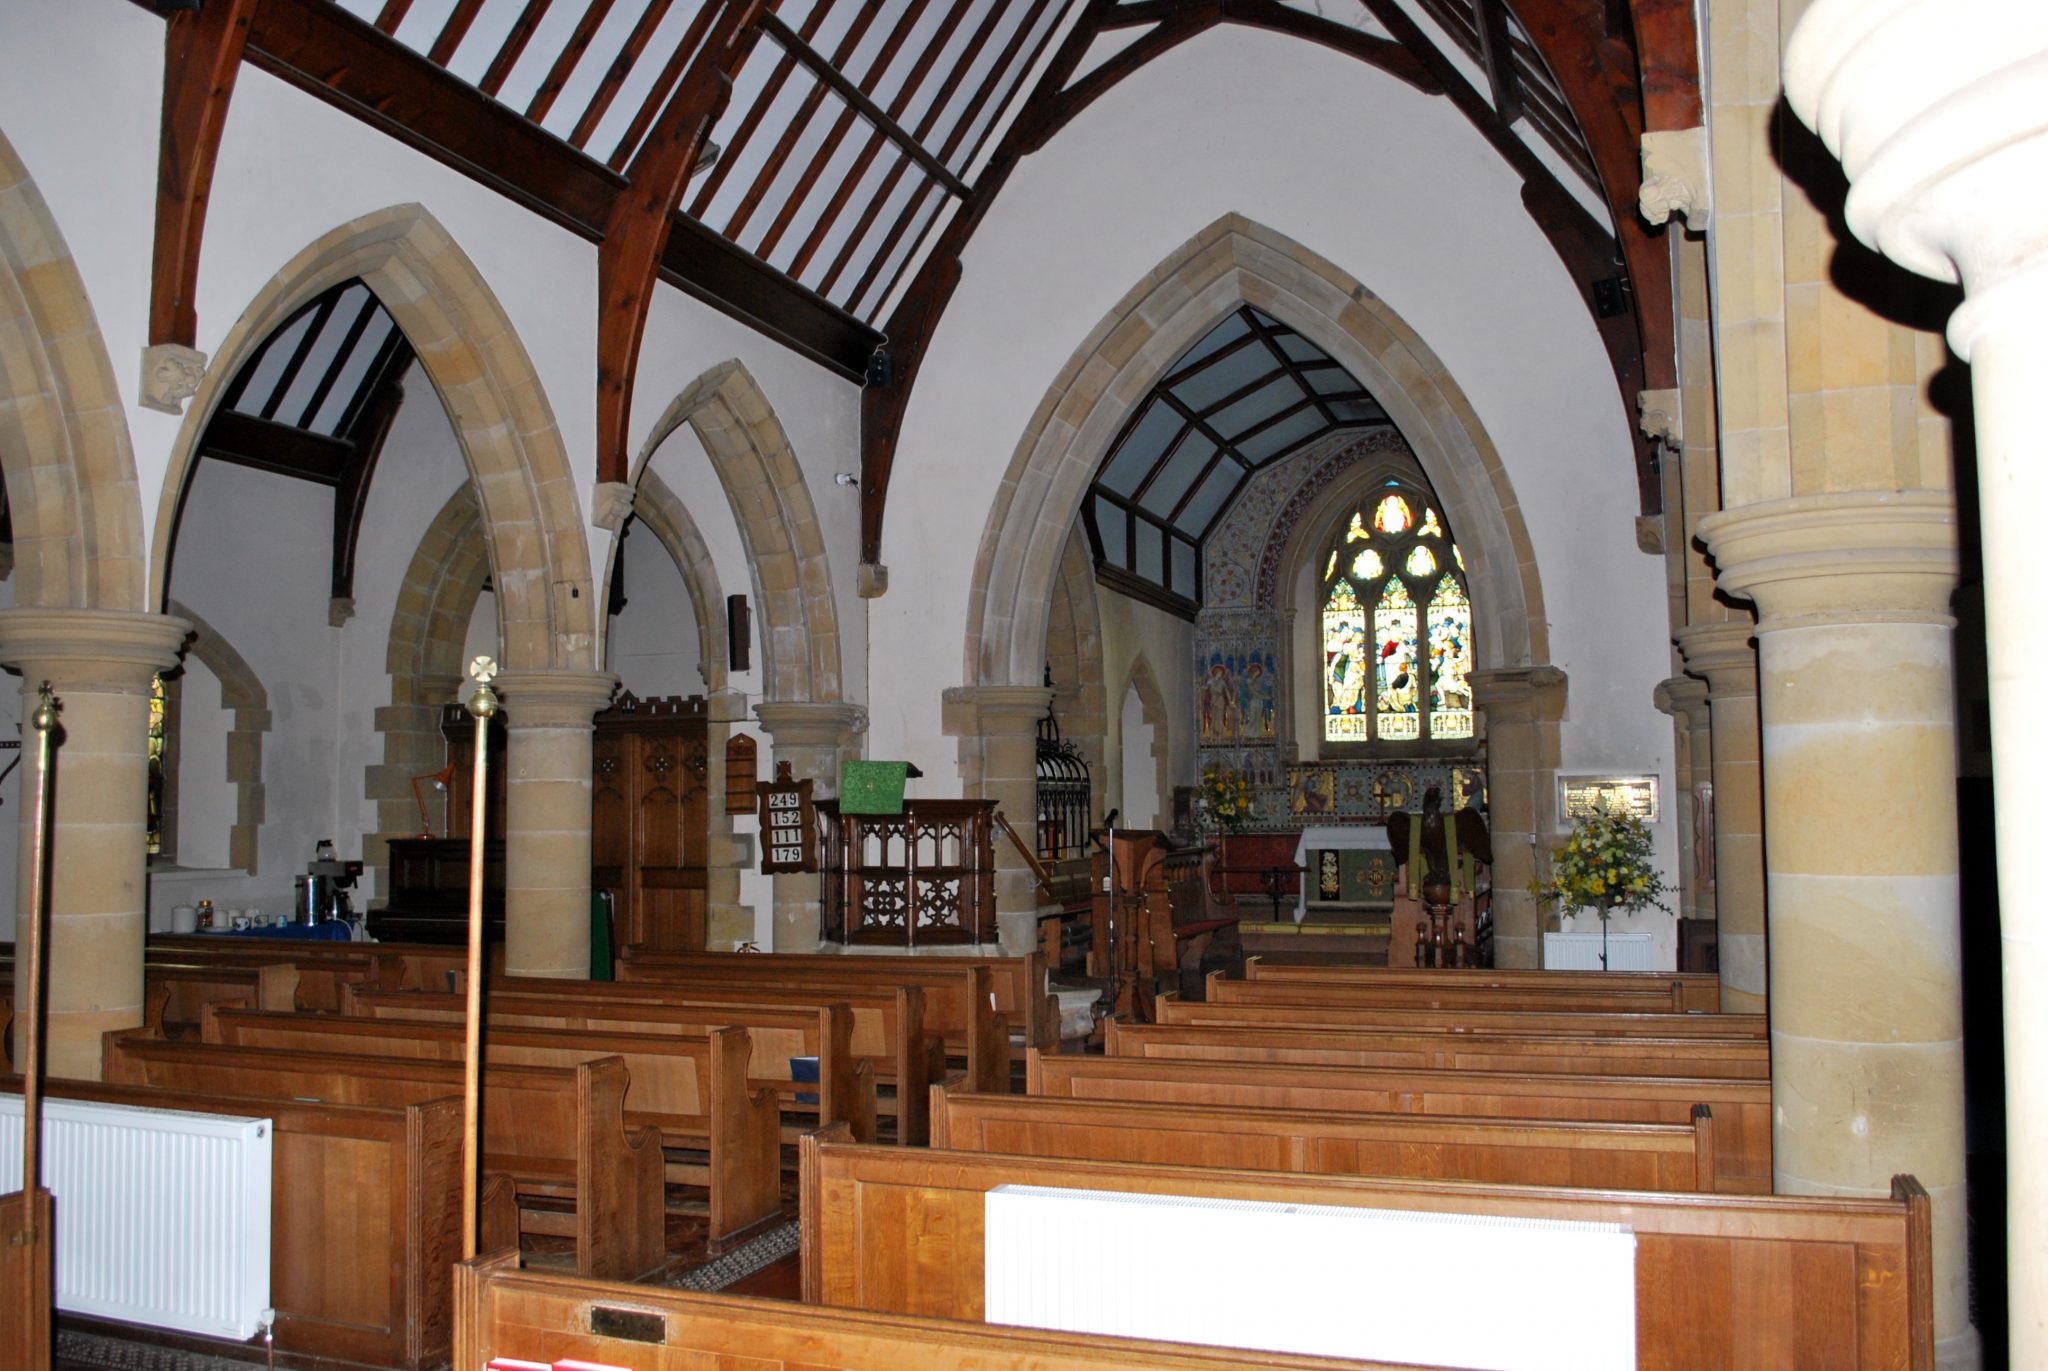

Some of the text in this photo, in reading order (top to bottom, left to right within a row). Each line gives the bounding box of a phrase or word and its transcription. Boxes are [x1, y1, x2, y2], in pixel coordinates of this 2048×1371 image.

[771, 793, 797, 806] 249
[774, 811, 799, 825] 152
[775, 829, 799, 843] 111
[775, 848, 800, 861] 179
